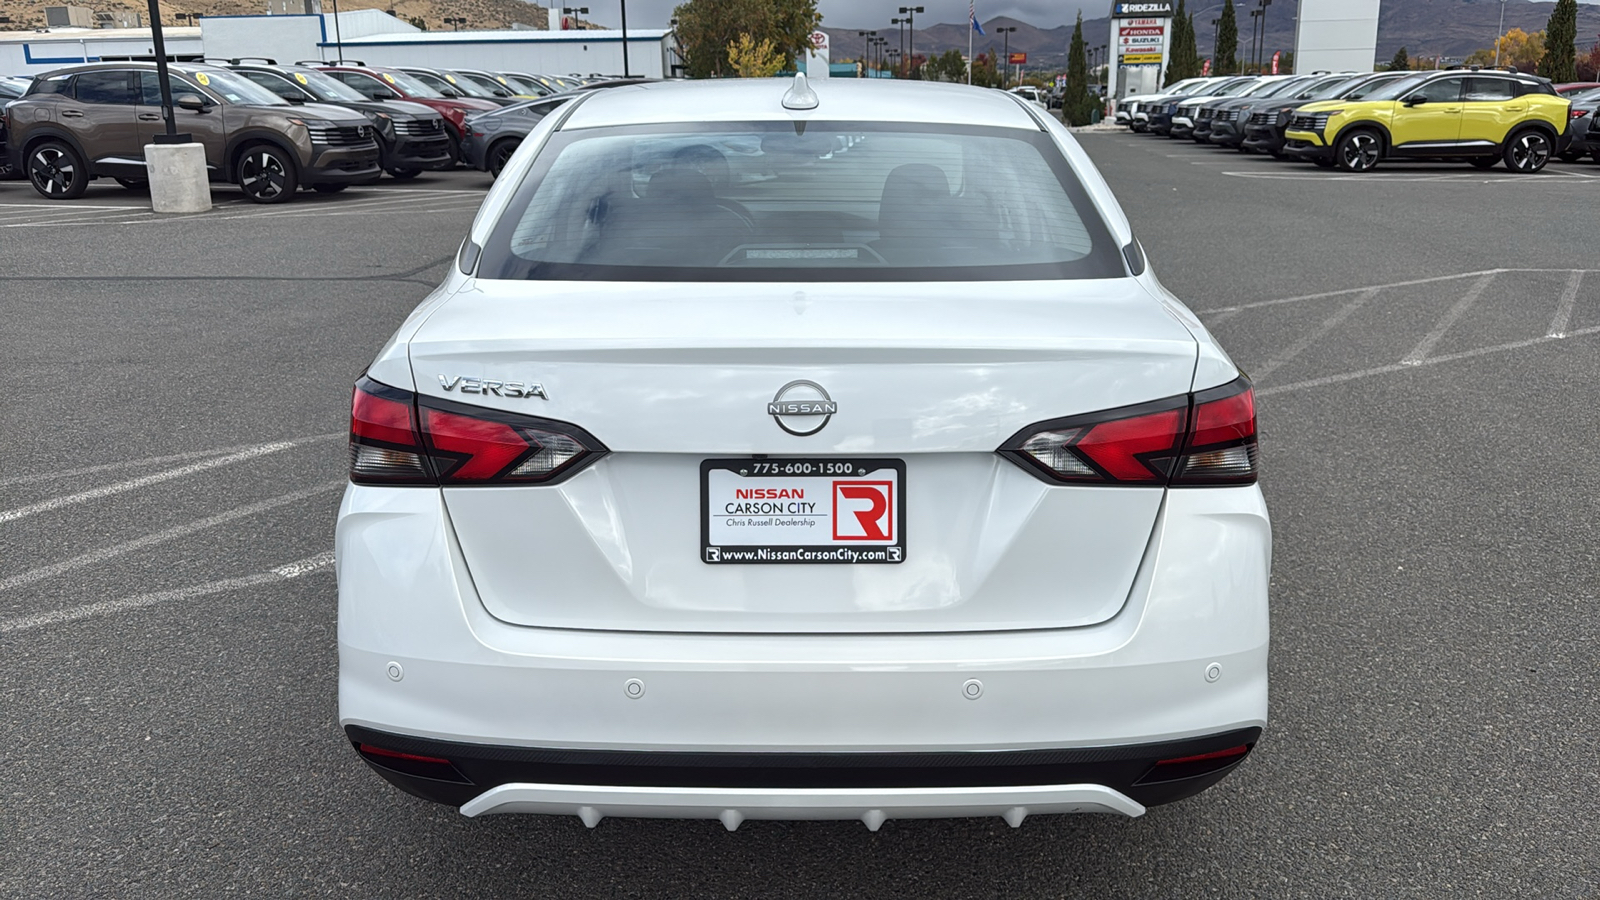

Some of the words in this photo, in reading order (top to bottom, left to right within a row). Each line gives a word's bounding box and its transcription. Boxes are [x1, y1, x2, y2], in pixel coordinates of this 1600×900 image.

[1129, 3, 1171, 12] RIDEZILLA
[438, 374, 549, 401] VERSA
[769, 403, 836, 413] NISSAN
[753, 463, 853, 474] 775-600-1500
[736, 488, 804, 499] NISSAN
[725, 502, 784, 514] CARSON
[787, 502, 816, 514] CITY
[726, 518, 746, 527] Chris
[747, 518, 773, 527] Russell
[774, 518, 816, 528] Dealership
[723, 548, 886, 563] www.NissanCarsonCity.com
